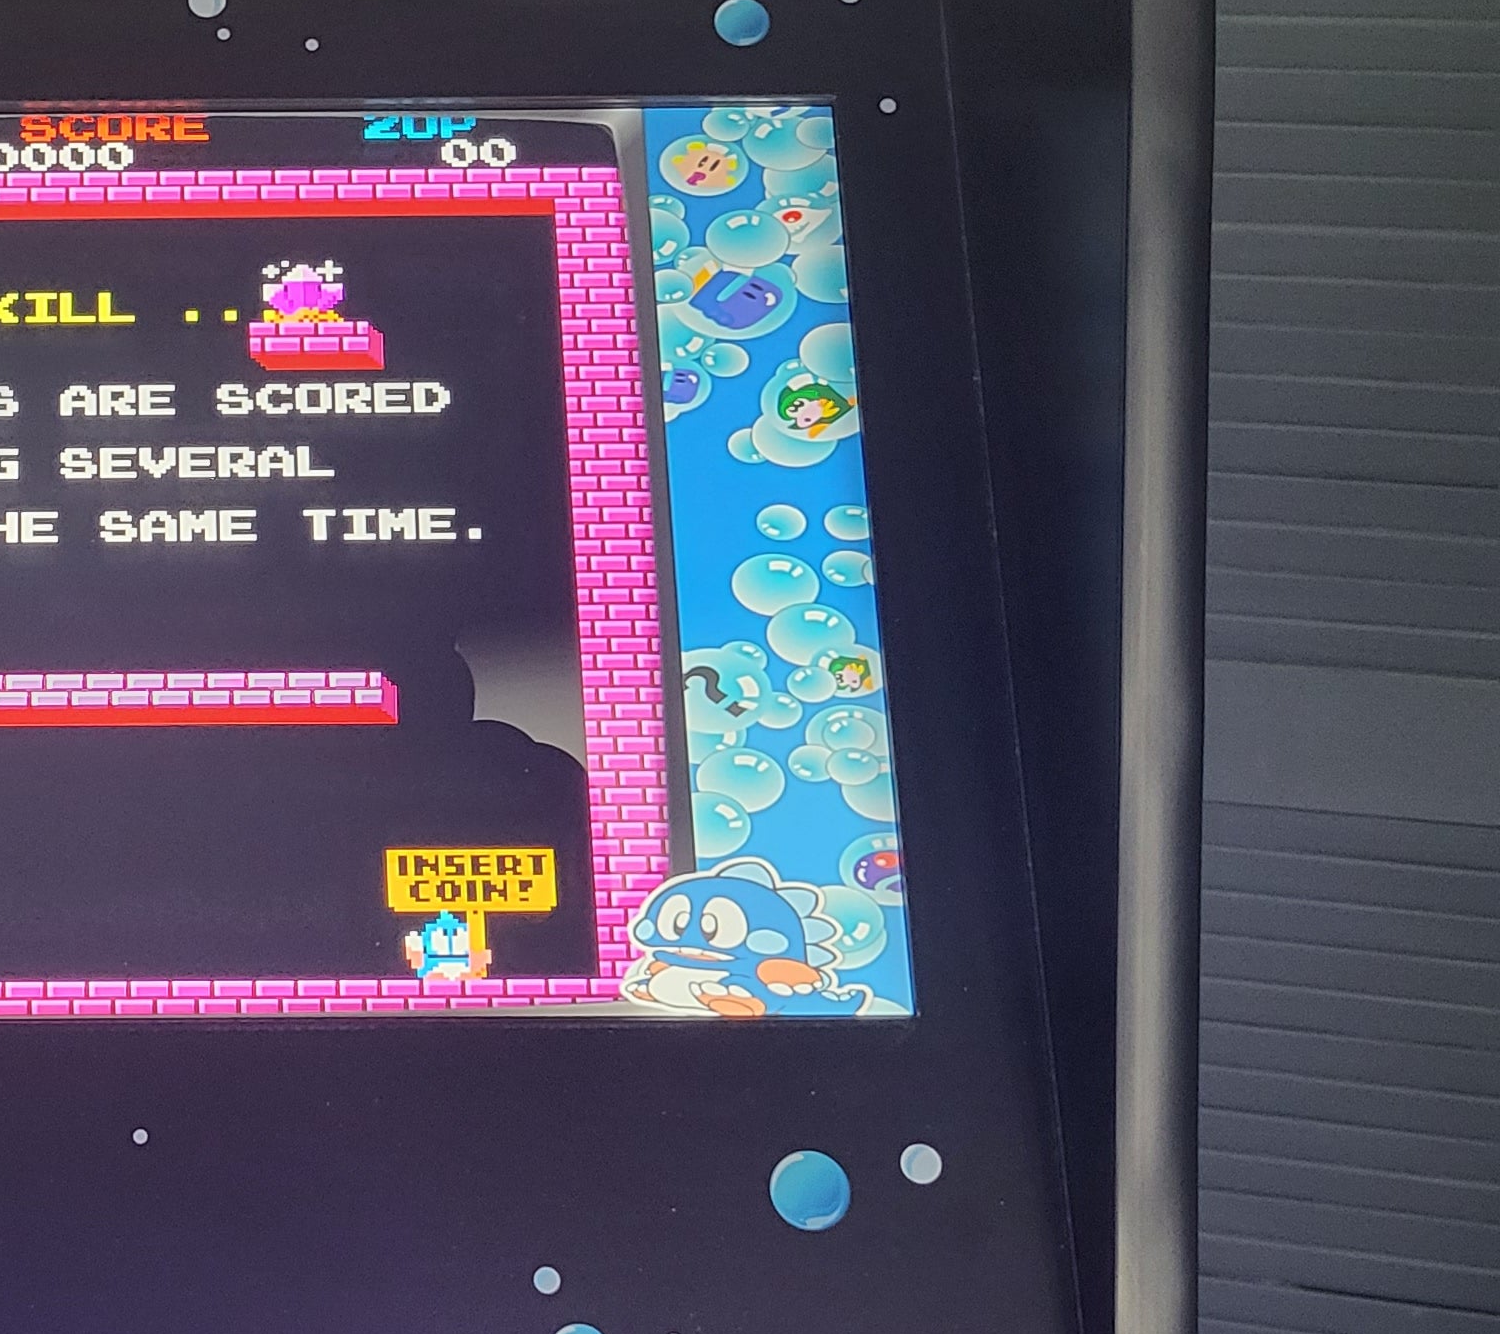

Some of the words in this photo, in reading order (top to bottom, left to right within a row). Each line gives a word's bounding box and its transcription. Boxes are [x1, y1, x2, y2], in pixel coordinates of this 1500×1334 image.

[19, 115, 209, 143] SCORE
[59, 384, 176, 417] ARE
[216, 381, 451, 415] SCORED
[59, 445, 335, 480] SEVERAL
[99, 509, 258, 543] SAME
[302, 507, 482, 541] TIME.
[397, 853, 548, 877] INSERT
